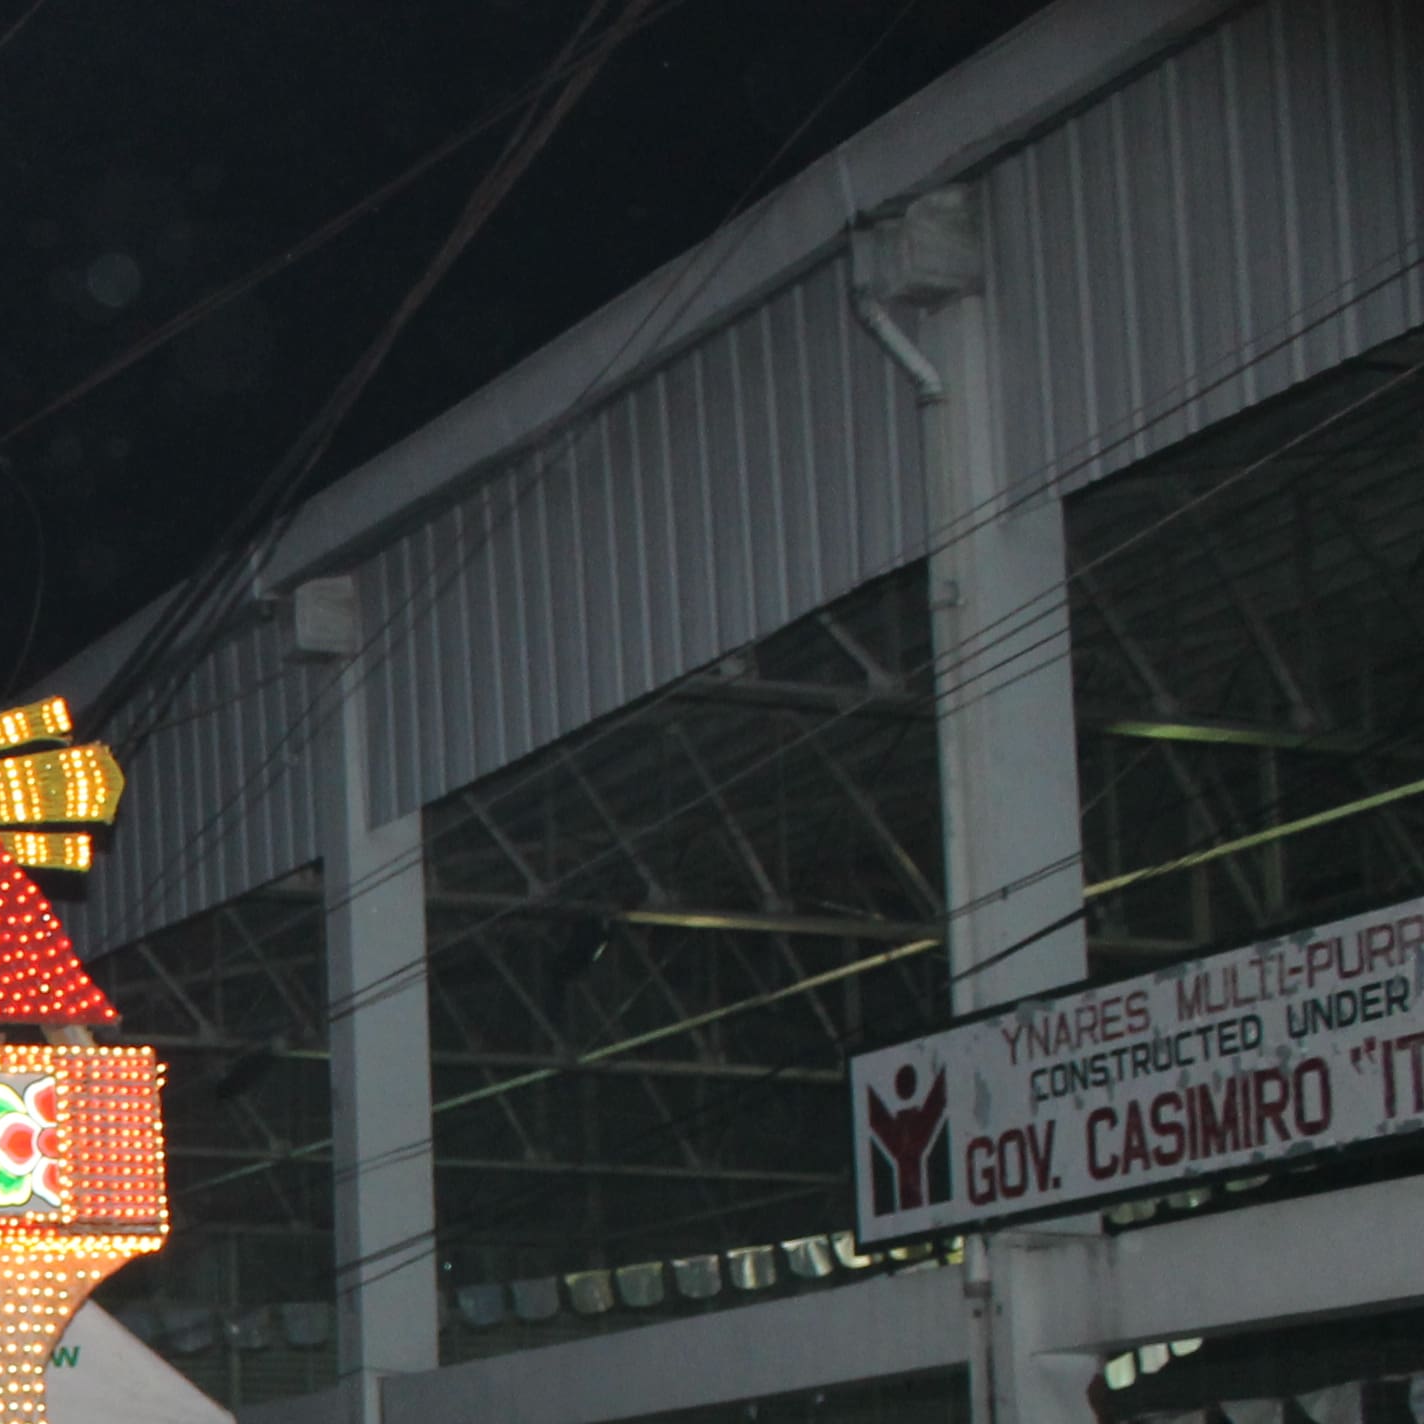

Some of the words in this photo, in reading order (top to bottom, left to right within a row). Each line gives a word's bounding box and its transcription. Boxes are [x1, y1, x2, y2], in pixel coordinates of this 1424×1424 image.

[1001, 990, 1151, 1067] YNARES
[1030, 1013, 1262, 1103] CONSTRUCTED
[1286, 975, 1410, 1040] UNDER
[966, 1119, 1062, 1207] GOV.
[1086, 1056, 1333, 1181] CASIMIRO
